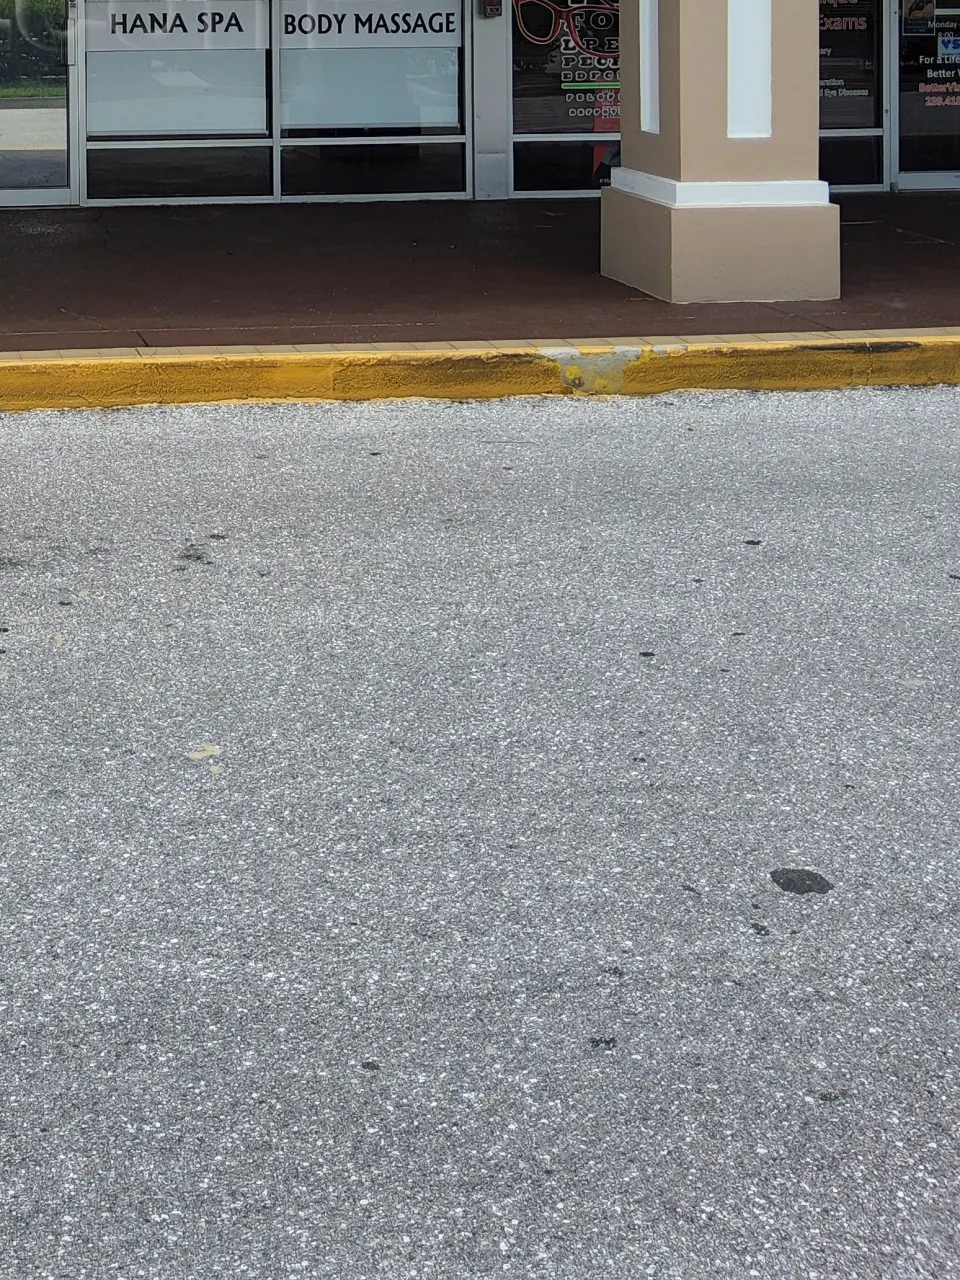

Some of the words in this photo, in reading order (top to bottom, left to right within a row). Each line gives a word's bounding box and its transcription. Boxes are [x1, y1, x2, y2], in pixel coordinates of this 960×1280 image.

[110, 12, 189, 34] HANA
[197, 11, 245, 34] SPA
[283, 12, 348, 35] BODY
[353, 11, 457, 34] MASSAGE
[927, 20, 958, 29] Monday
[919, 55, 935, 64] For
[927, 68, 956, 78] Better
